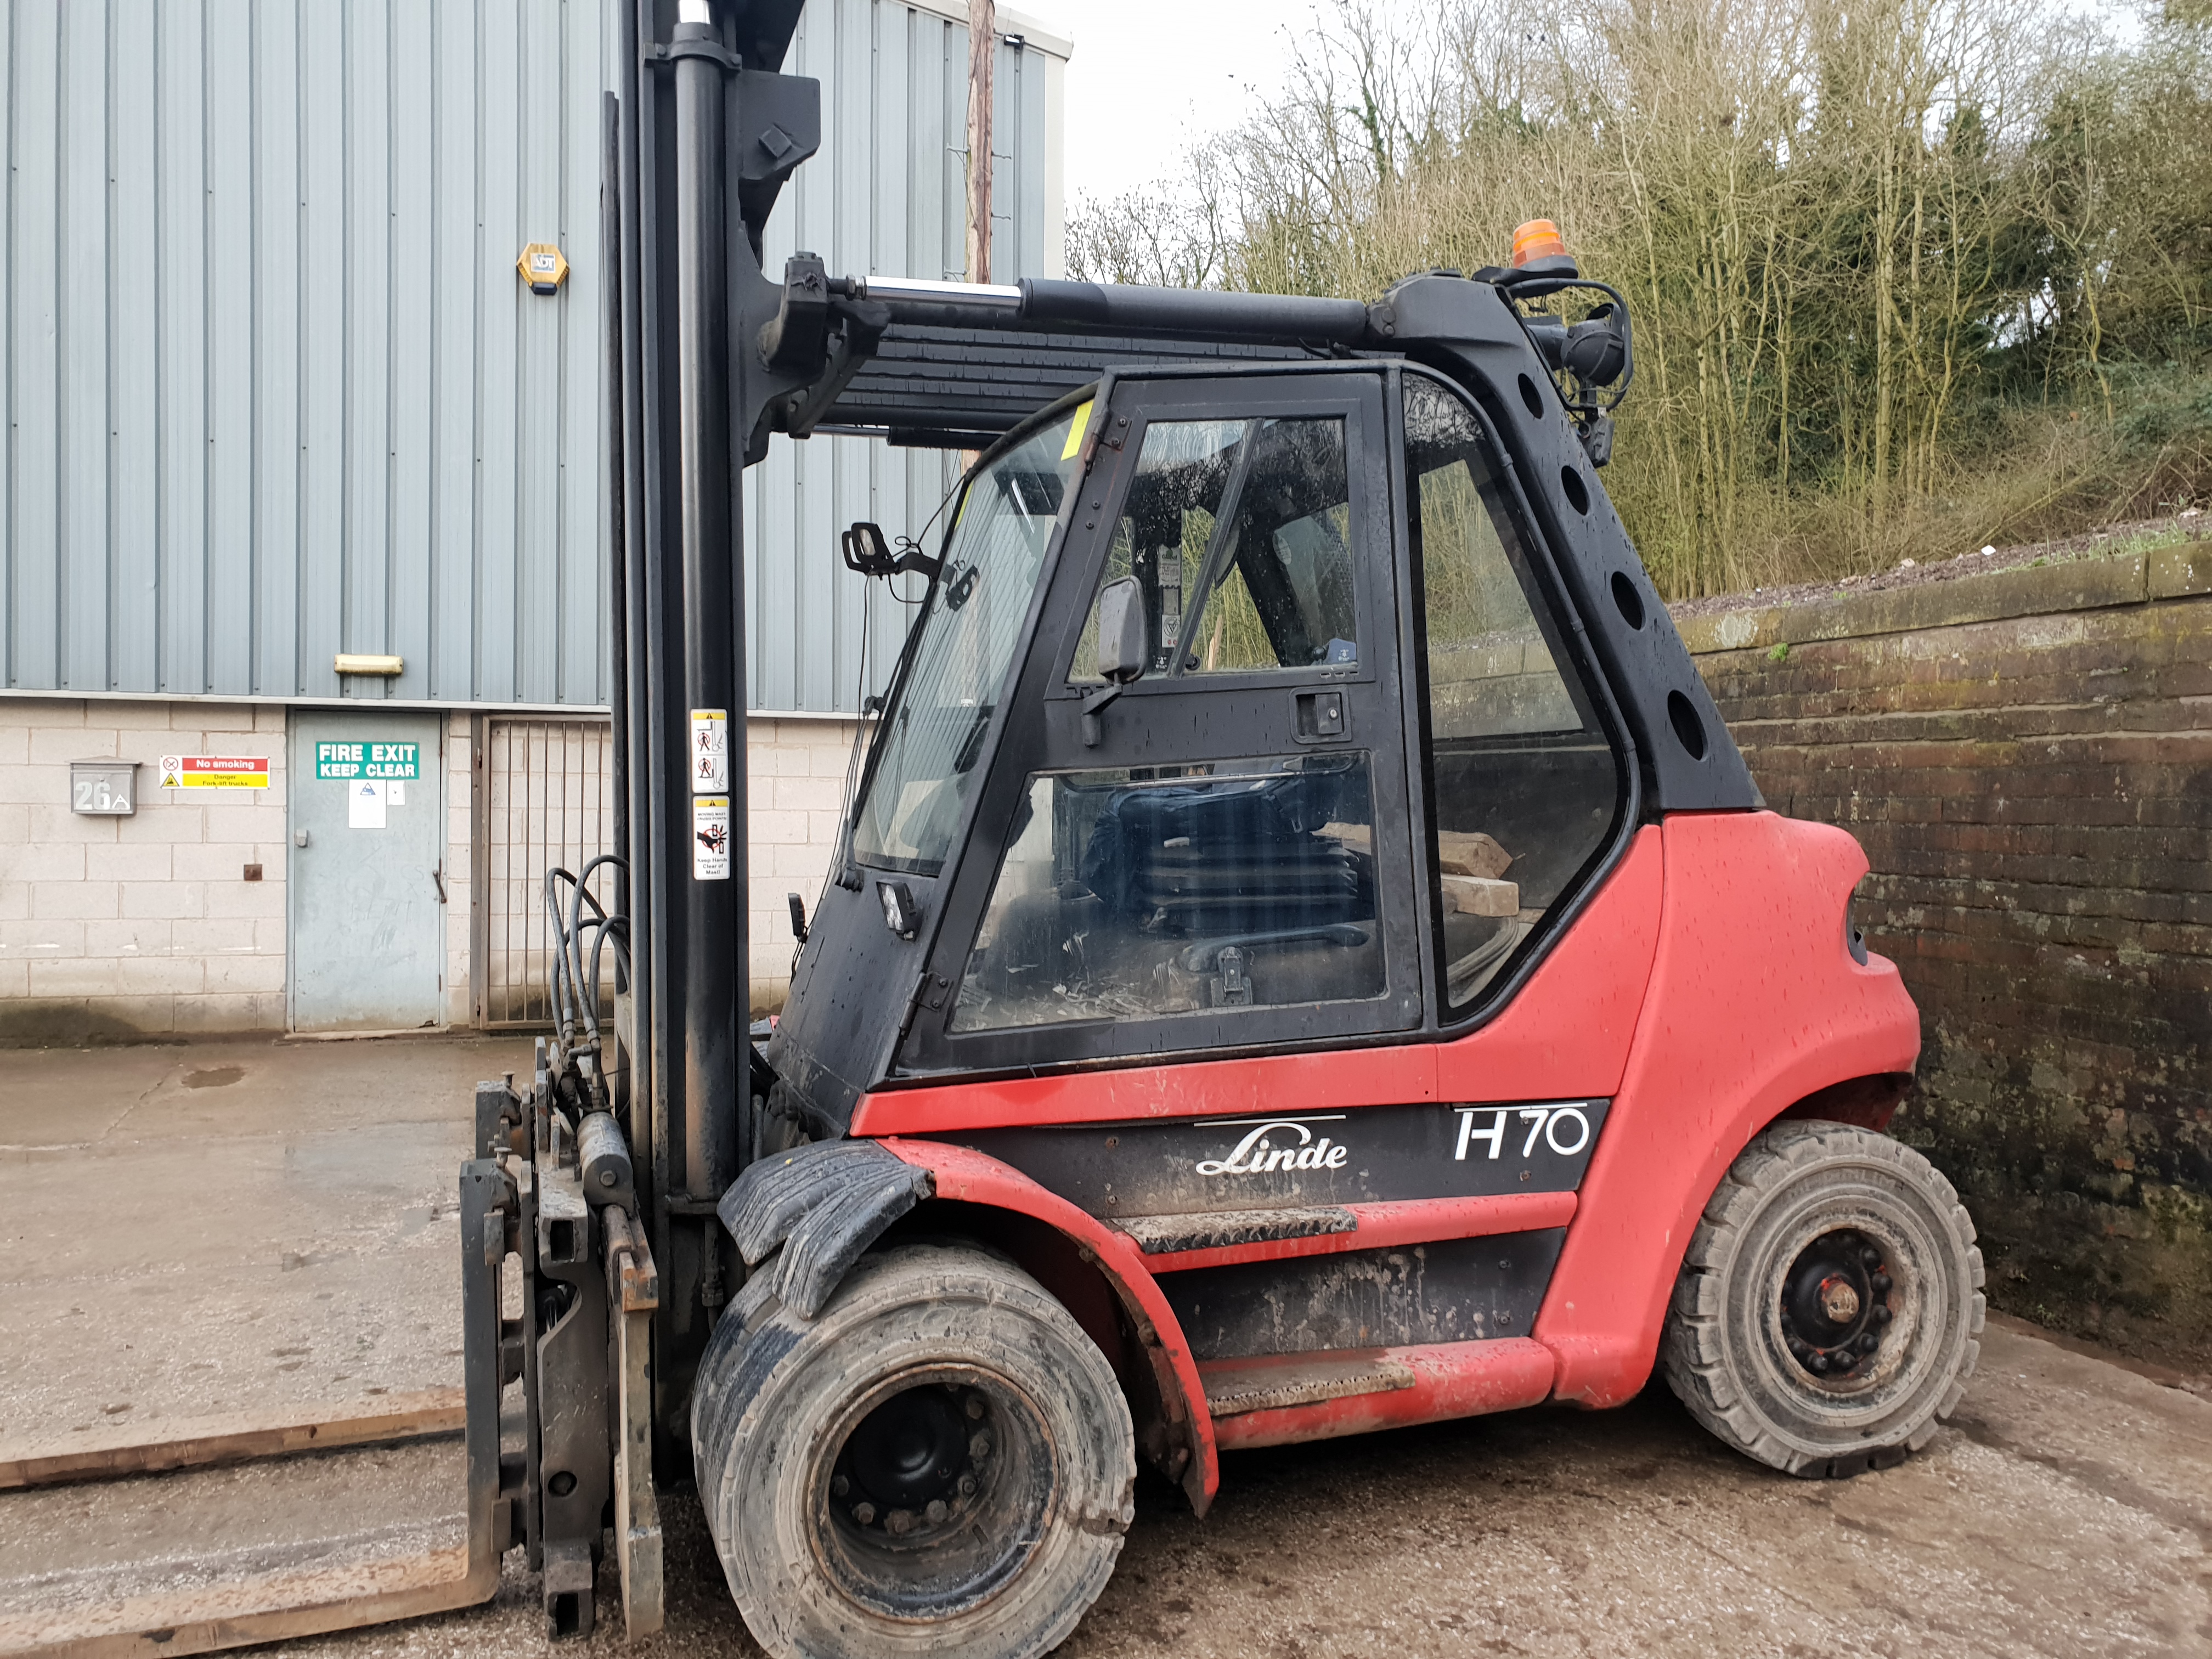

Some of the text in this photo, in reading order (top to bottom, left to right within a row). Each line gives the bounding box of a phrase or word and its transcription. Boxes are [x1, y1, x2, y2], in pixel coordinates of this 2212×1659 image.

[319, 744, 416, 761] FIRE EXIT
[196, 759, 255, 770] No smoking
[320, 764, 415, 777] KEEP CLEAR
[1195, 1122, 1347, 1176] Linde
